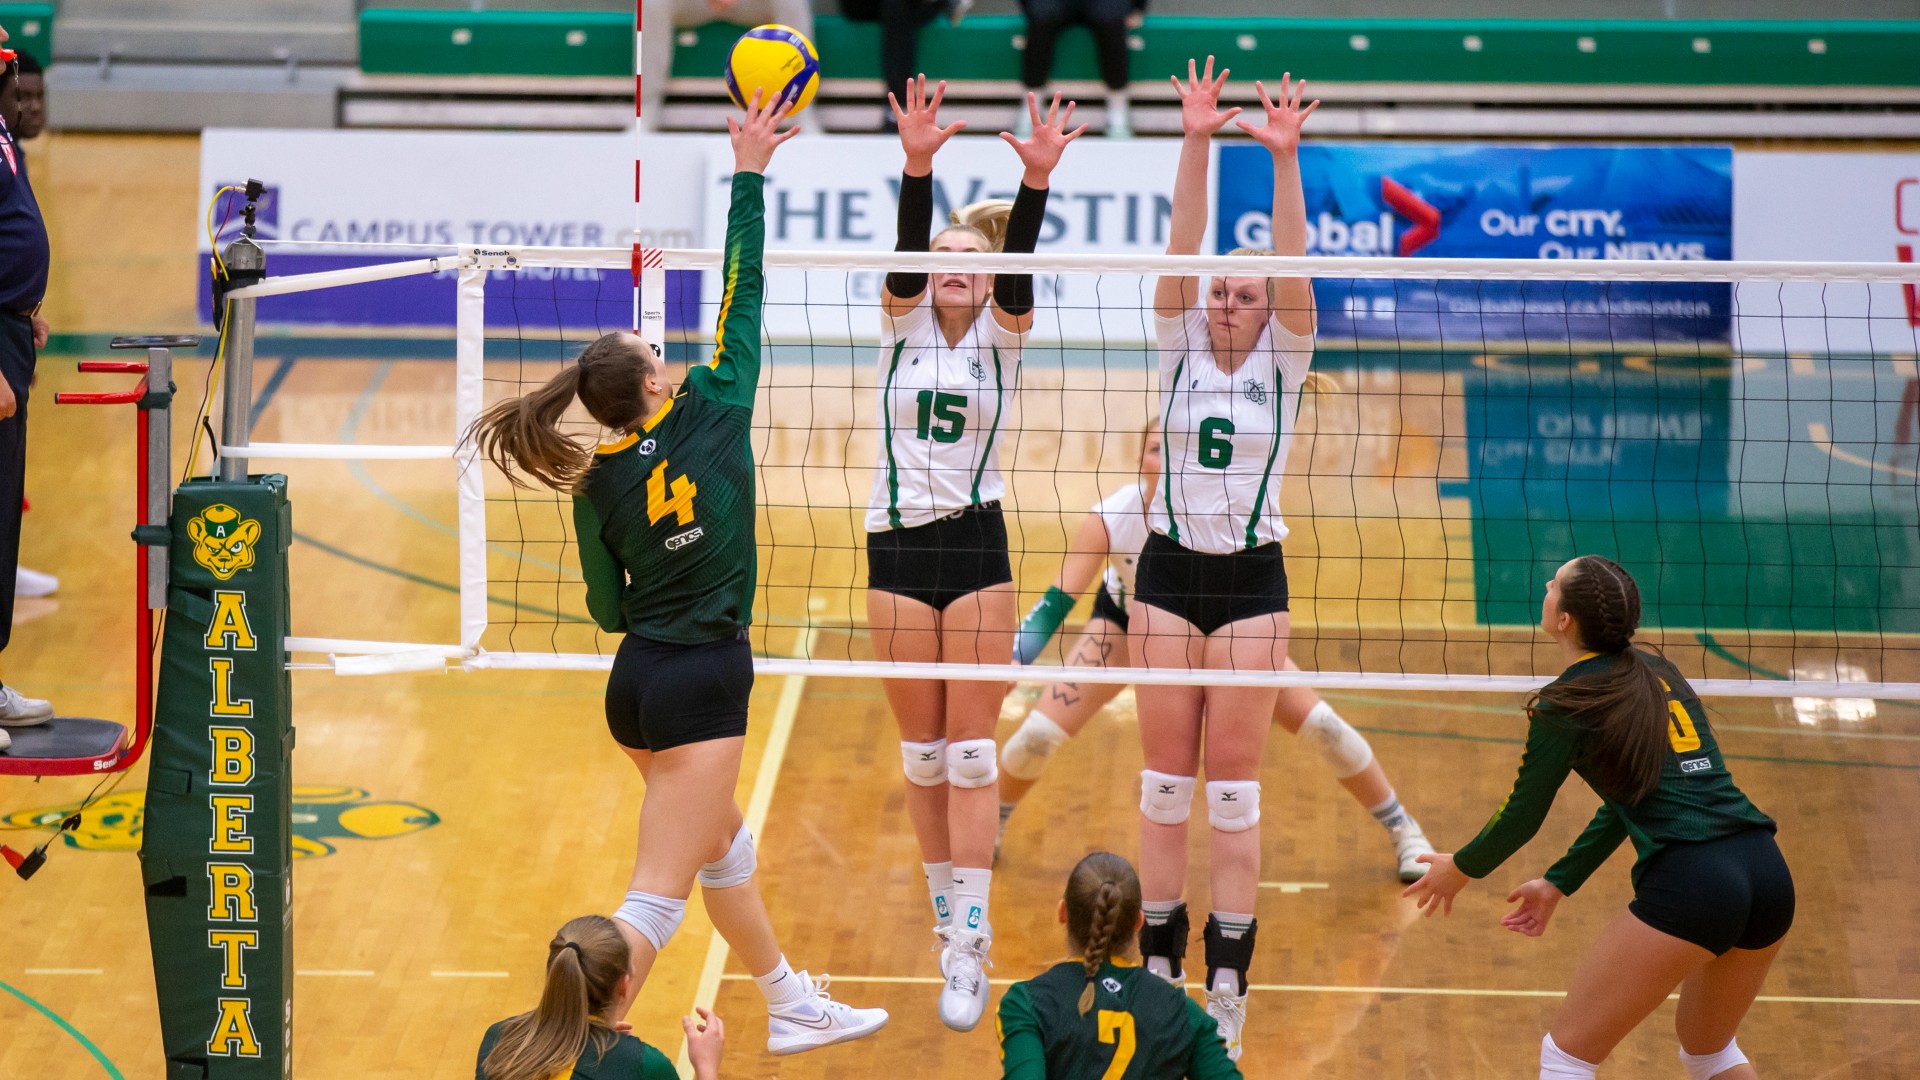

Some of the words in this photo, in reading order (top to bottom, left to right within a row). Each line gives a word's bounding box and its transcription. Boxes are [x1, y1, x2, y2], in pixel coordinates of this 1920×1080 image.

[290, 219, 452, 246] CAMPUS
[467, 219, 601, 247] TOWER
[719, 177, 873, 240] HE
[1234, 211, 1394, 251] Gbal
[1480, 209, 1539, 237] Our
[1545, 209, 1626, 237] CITY.
[1538, 241, 1600, 260] Our
[916, 390, 967, 443] 15
[1198, 416, 1235, 469] 6
[646, 458, 697, 527] 4
[216, 525, 226, 537] A
[204, 589, 261, 1058] ALBERTA
[1098, 1009, 1136, 1080] 7
